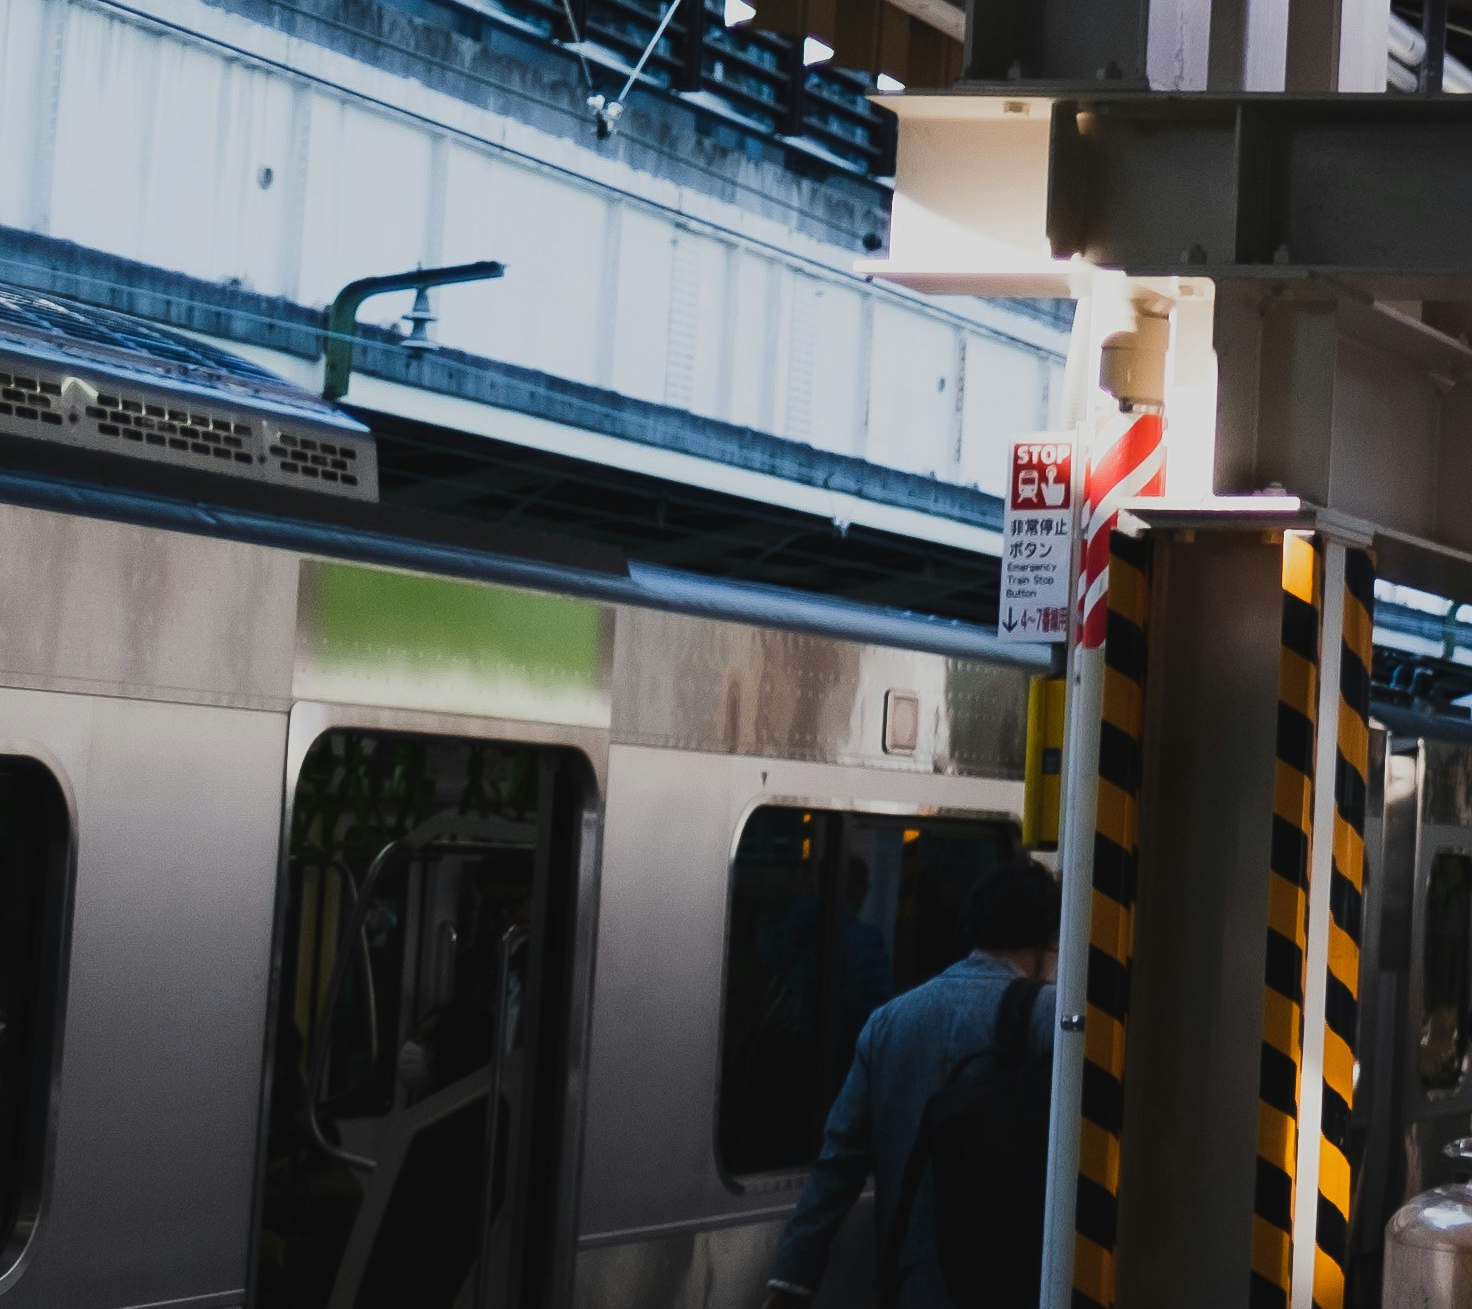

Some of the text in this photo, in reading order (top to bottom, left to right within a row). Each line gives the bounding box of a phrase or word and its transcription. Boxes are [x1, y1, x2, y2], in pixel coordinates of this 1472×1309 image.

[1016, 444, 1070, 465] STOP
[1011, 518, 1068, 537] 非常停止
[1009, 542, 1053, 559] ボタン
